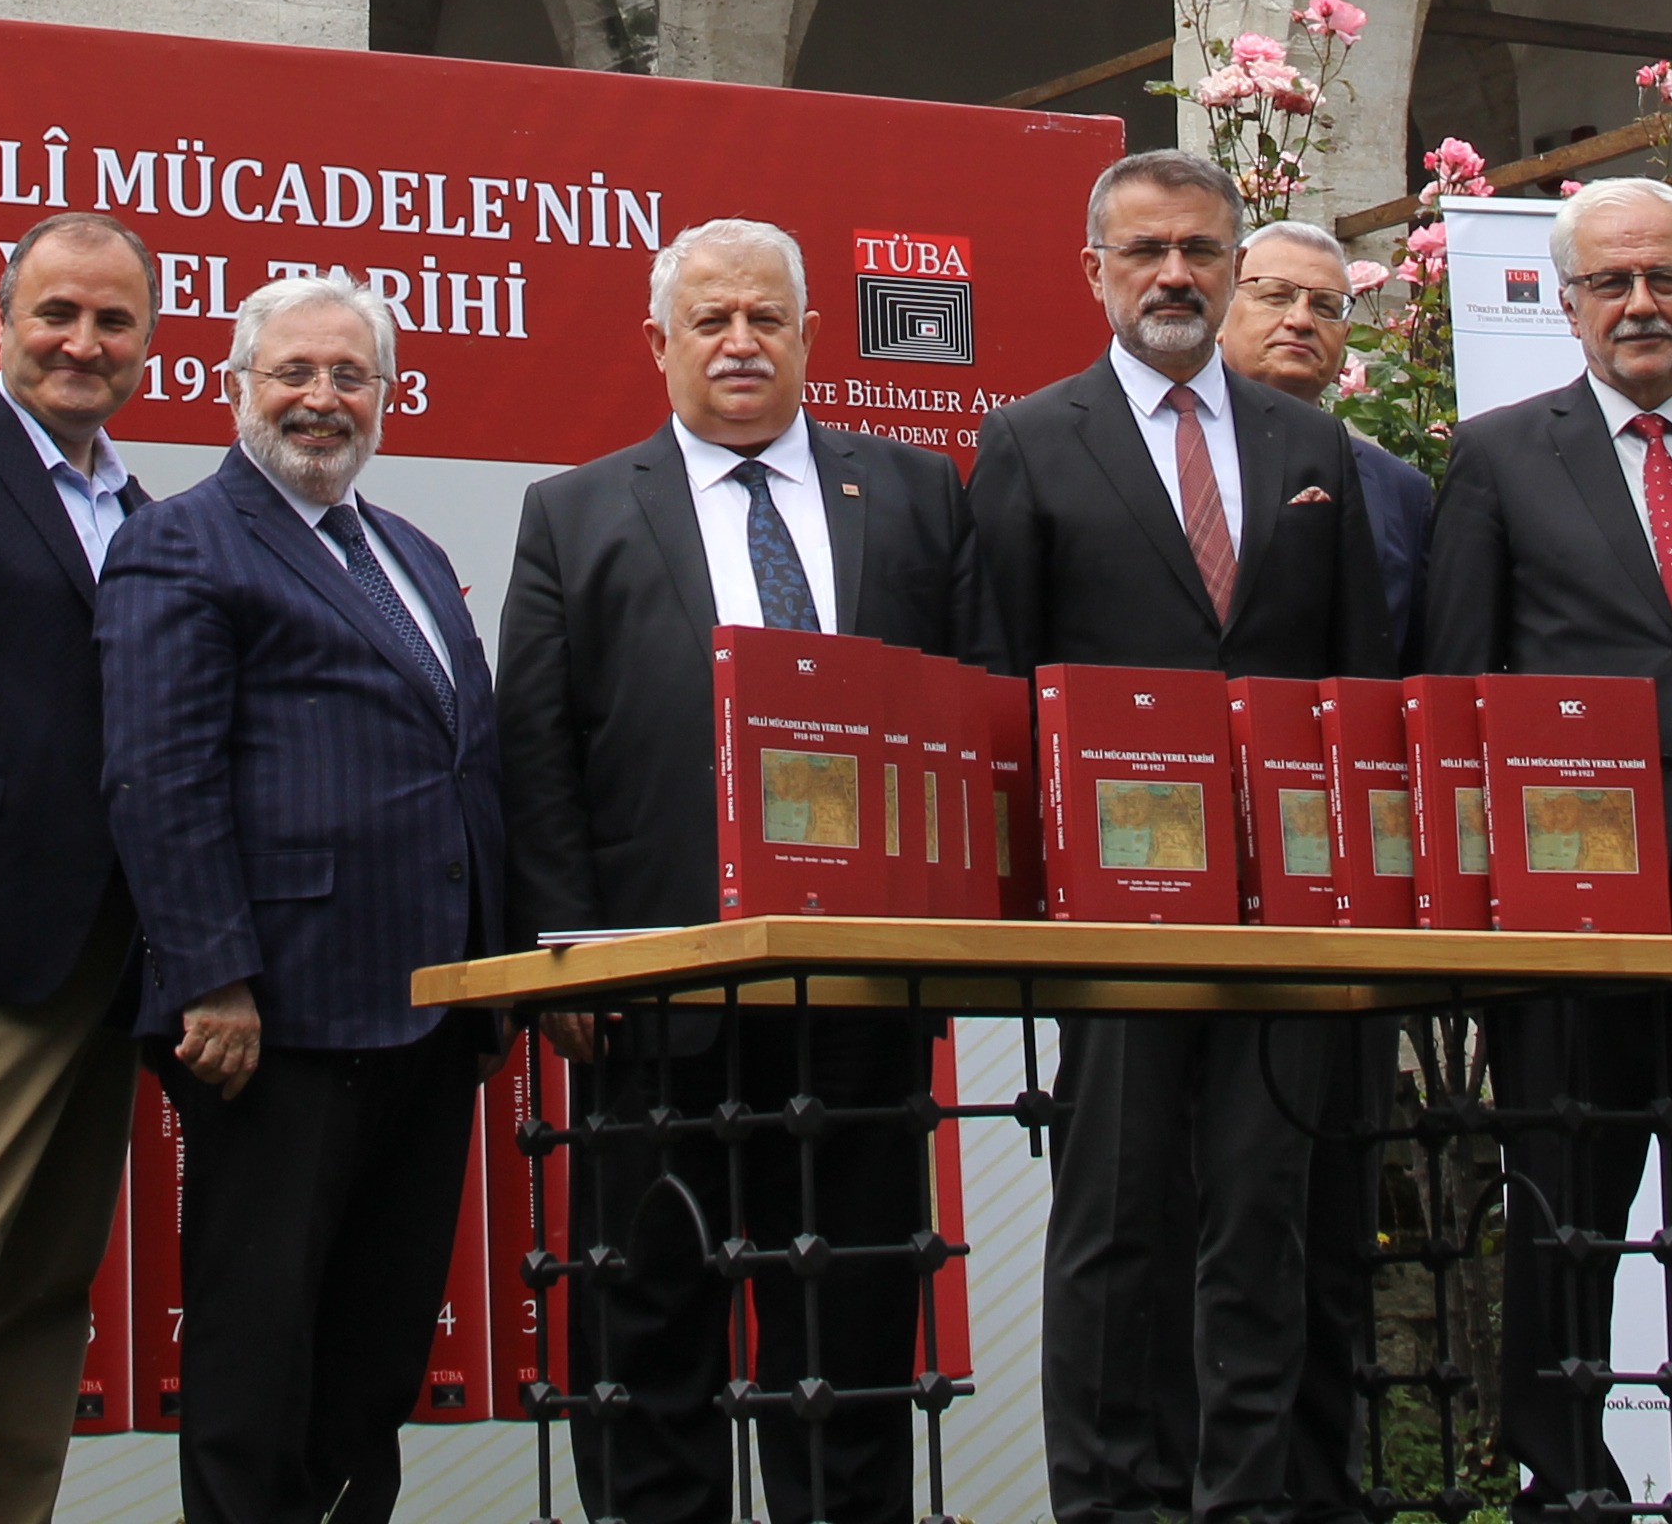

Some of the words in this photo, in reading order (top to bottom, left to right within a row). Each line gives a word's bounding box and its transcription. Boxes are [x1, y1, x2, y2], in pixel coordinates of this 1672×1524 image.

[92, 138, 663, 252] MÜCADELE'NİN
[857, 233, 969, 277] TÜBA
[844, 379, 963, 413] BİLİMLER
[725, 863, 735, 878] 2
[1057, 888, 1066, 903] 1
[1247, 895, 1260, 910] 10
[1336, 895, 1351, 910] 11
[1418, 894, 1431, 909] 12
[161, 1089, 172, 1138] 8-1923
[437, 1301, 457, 1337] 4
[522, 1299, 538, 1334] 3
[168, 1307, 184, 1343] 7
[432, 1369, 464, 1382] TÜBA
[519, 1367, 538, 1380] TÜ
[161, 1377, 180, 1390] TÜ
[1606, 1395, 1670, 1411] ook.com
